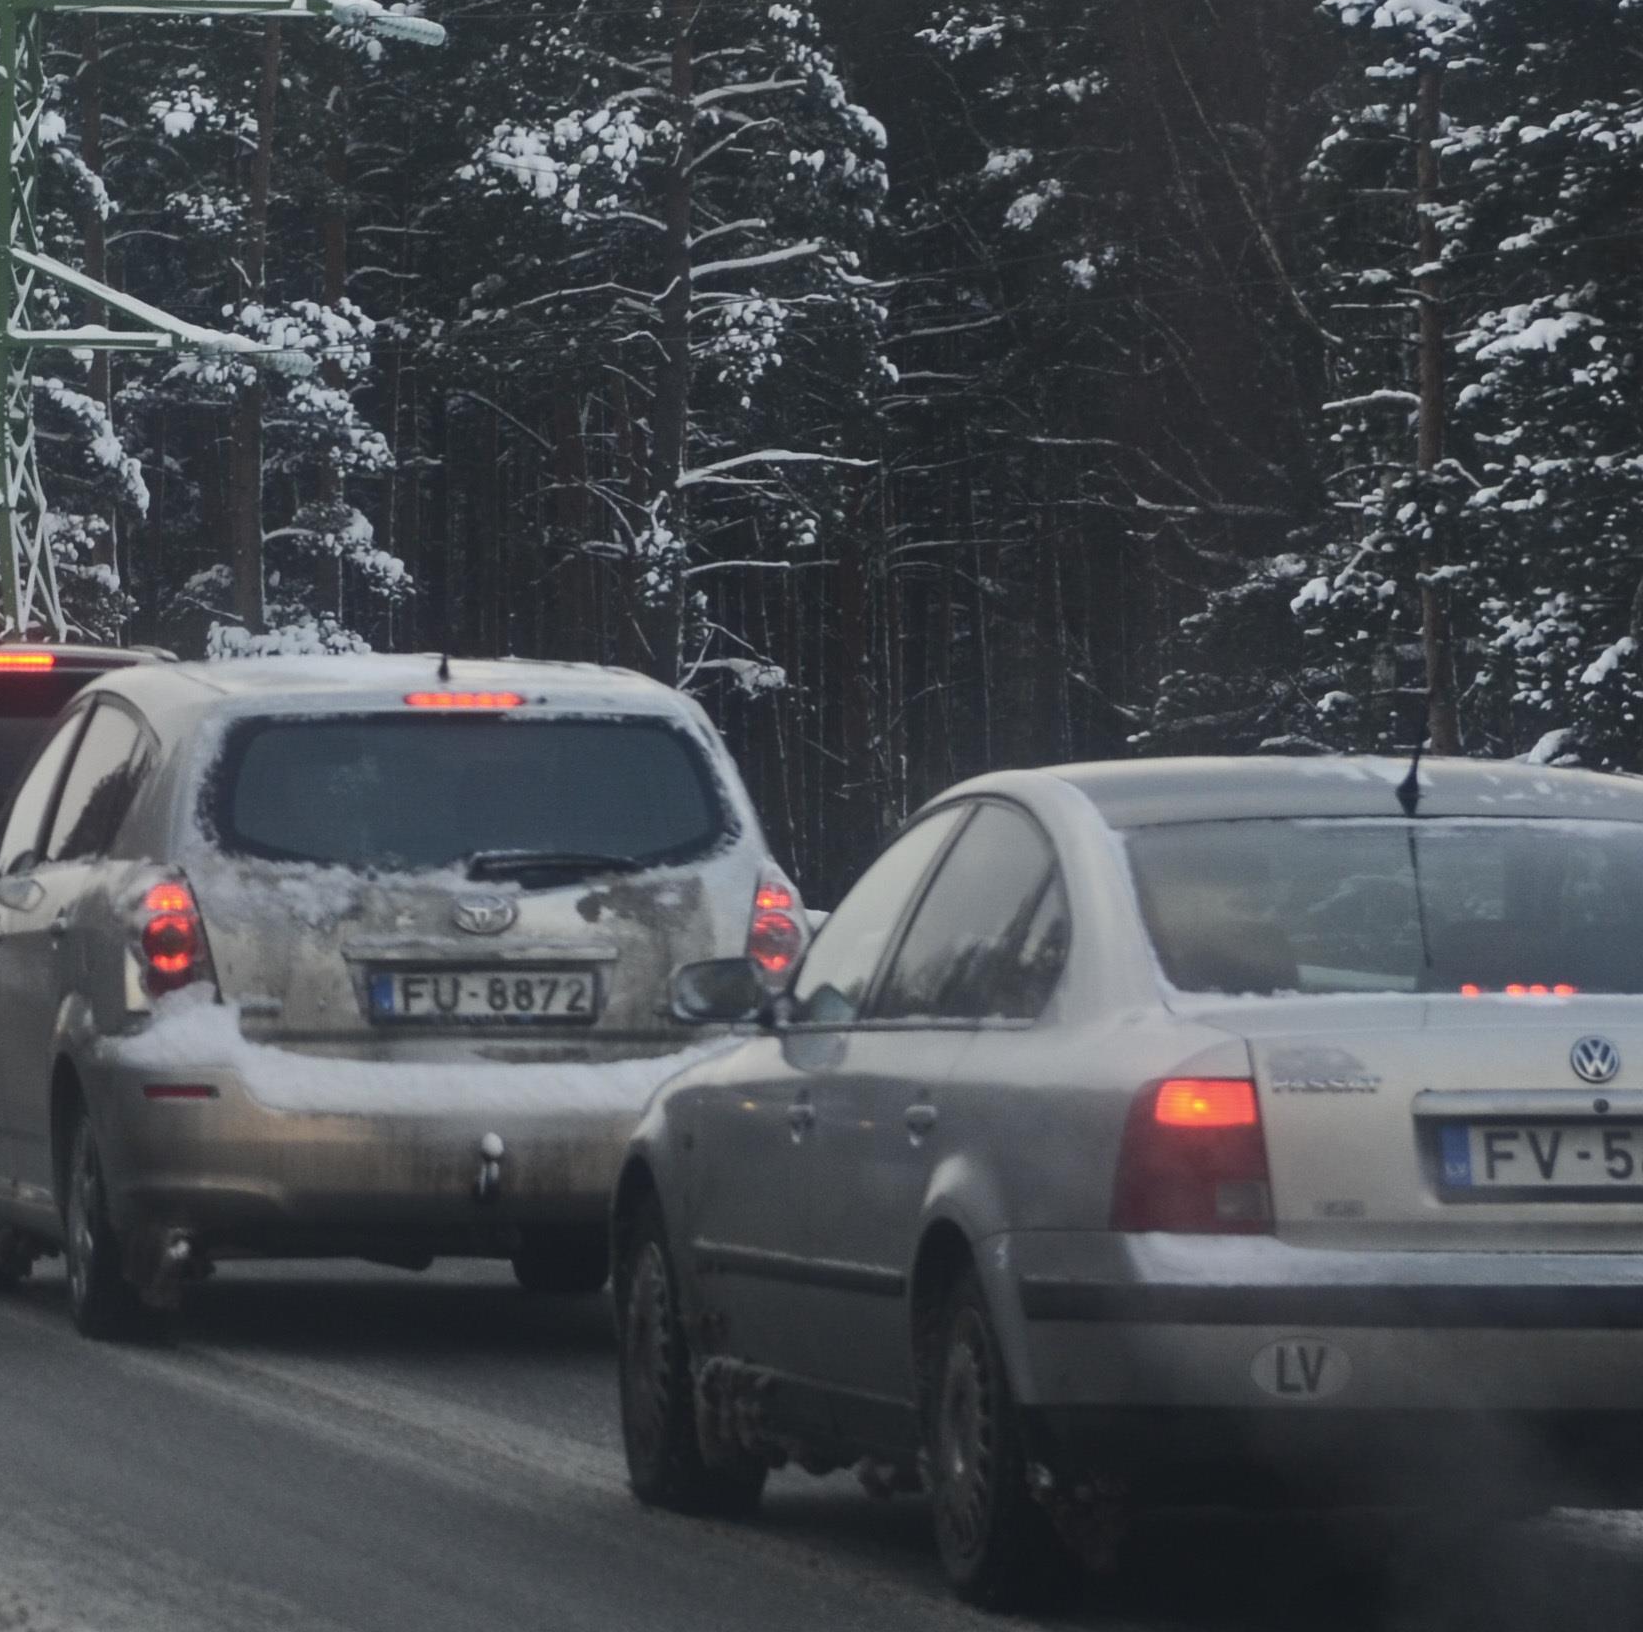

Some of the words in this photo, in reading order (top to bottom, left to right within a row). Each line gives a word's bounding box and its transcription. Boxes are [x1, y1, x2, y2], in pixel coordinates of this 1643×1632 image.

[400, 975, 588, 1013] FU-8872
[1483, 1128, 1643, 1180] FV-5
[1275, 1345, 1326, 1393] LV
